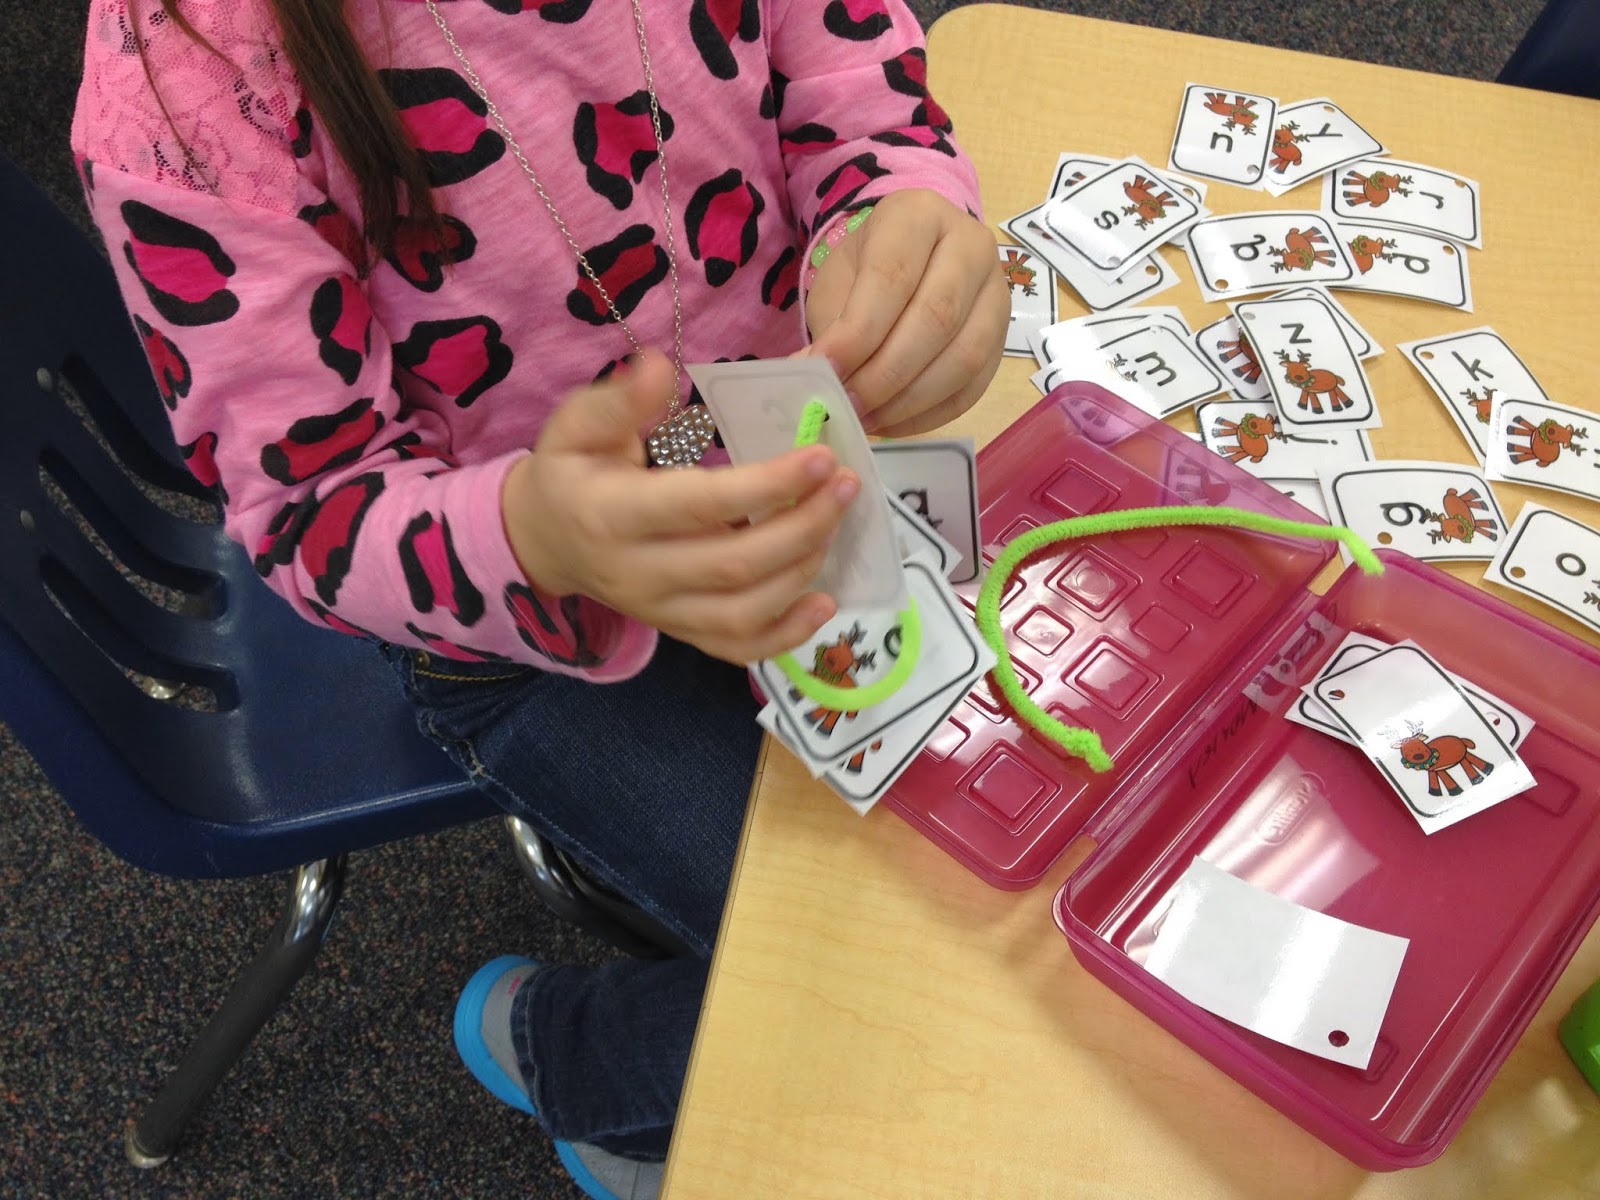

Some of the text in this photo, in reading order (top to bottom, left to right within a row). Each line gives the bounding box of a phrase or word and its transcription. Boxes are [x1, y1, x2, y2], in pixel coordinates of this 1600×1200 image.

[1307, 122, 1343, 137] y
[1210, 131, 1233, 153] u
[1419, 191, 1444, 209] r
[1093, 210, 1119, 230] s
[1230, 234, 1266, 261] q
[1392, 252, 1430, 274] p
[1280, 323, 1312, 344] z
[1134, 351, 1177, 386] m
[1451, 350, 1494, 381] k
[1379, 501, 1427, 527] g
[1555, 552, 1586, 576] o
